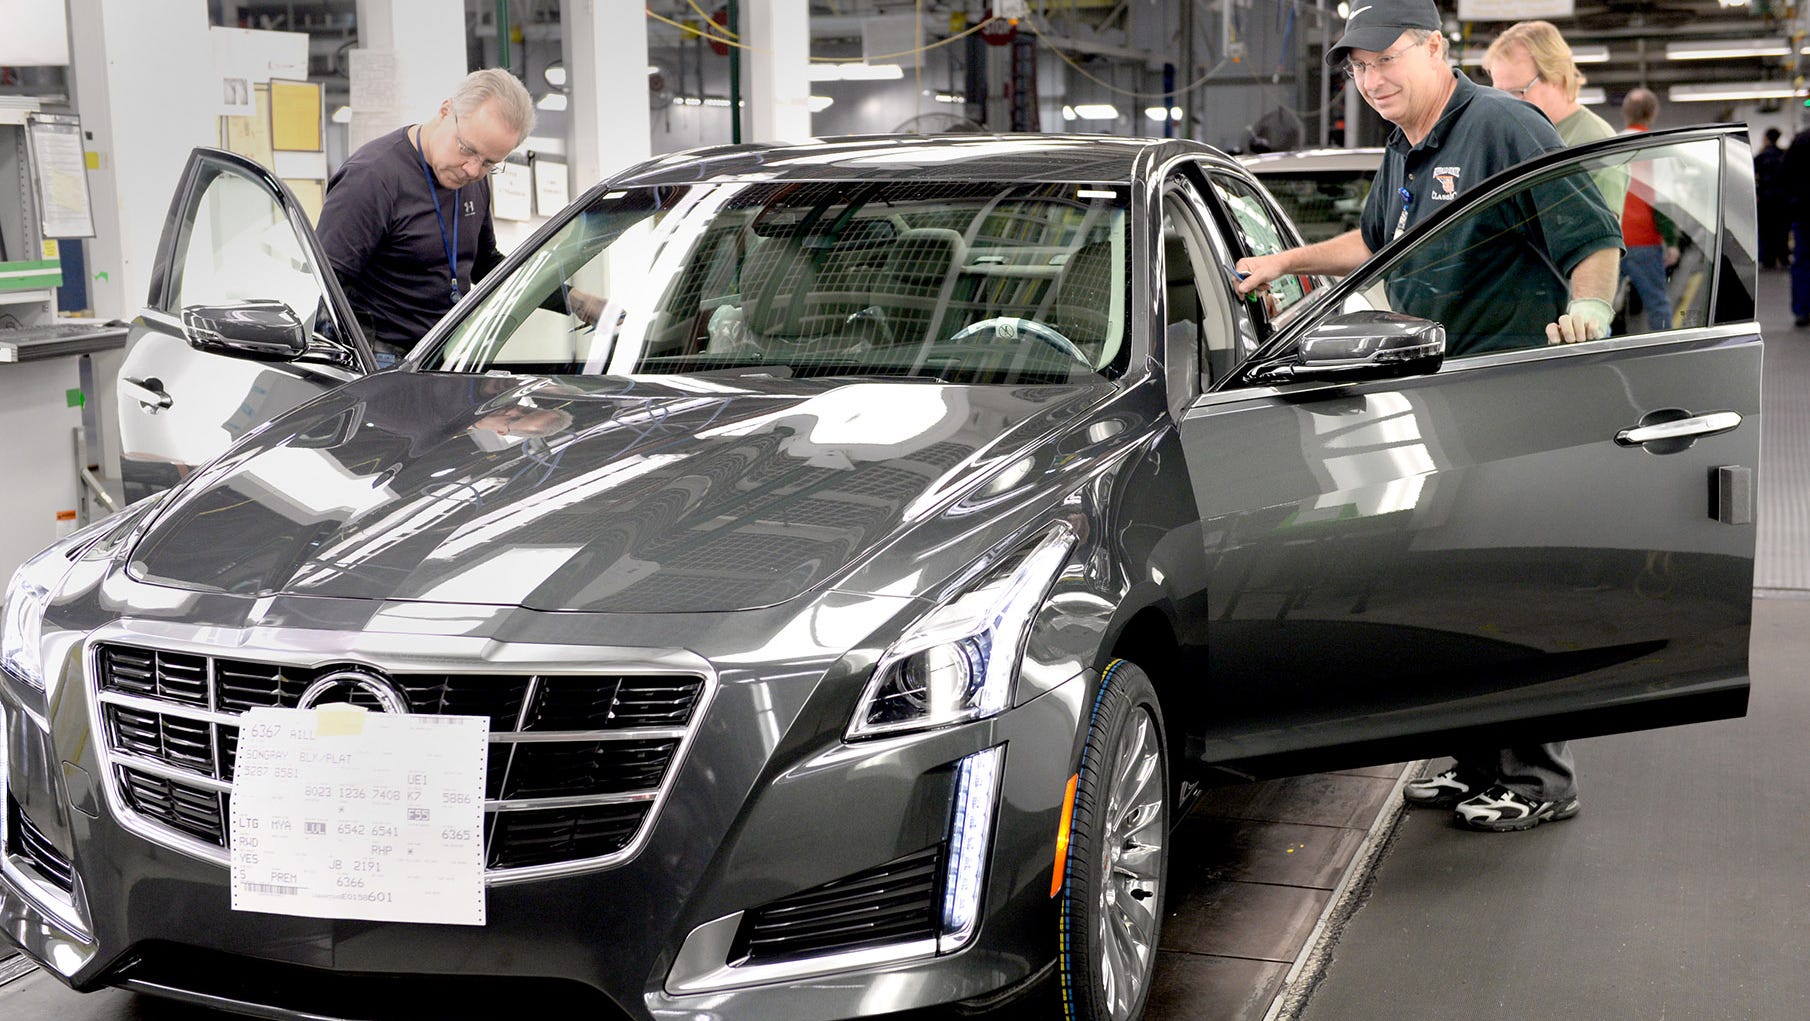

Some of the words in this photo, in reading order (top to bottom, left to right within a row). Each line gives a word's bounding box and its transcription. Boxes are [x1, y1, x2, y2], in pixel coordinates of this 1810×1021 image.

[251, 724, 281, 738] 6367
[299, 751, 352, 765] BLK/PLAT
[244, 765, 269, 776] 5287
[407, 775, 428, 786] UE1
[304, 786, 331, 797] 8023
[339, 787, 366, 799] 1236
[372, 789, 400, 801] 7408
[442, 792, 471, 804] 5886
[238, 818, 259, 829] LTG
[337, 824, 365, 835] 6542
[371, 826, 399, 837] 6541
[441, 829, 471, 841] 6365
[239, 853, 259, 864] YES
[353, 861, 380, 872] 2191
[271, 872, 297, 883] PREM
[336, 876, 365, 888] 6366
